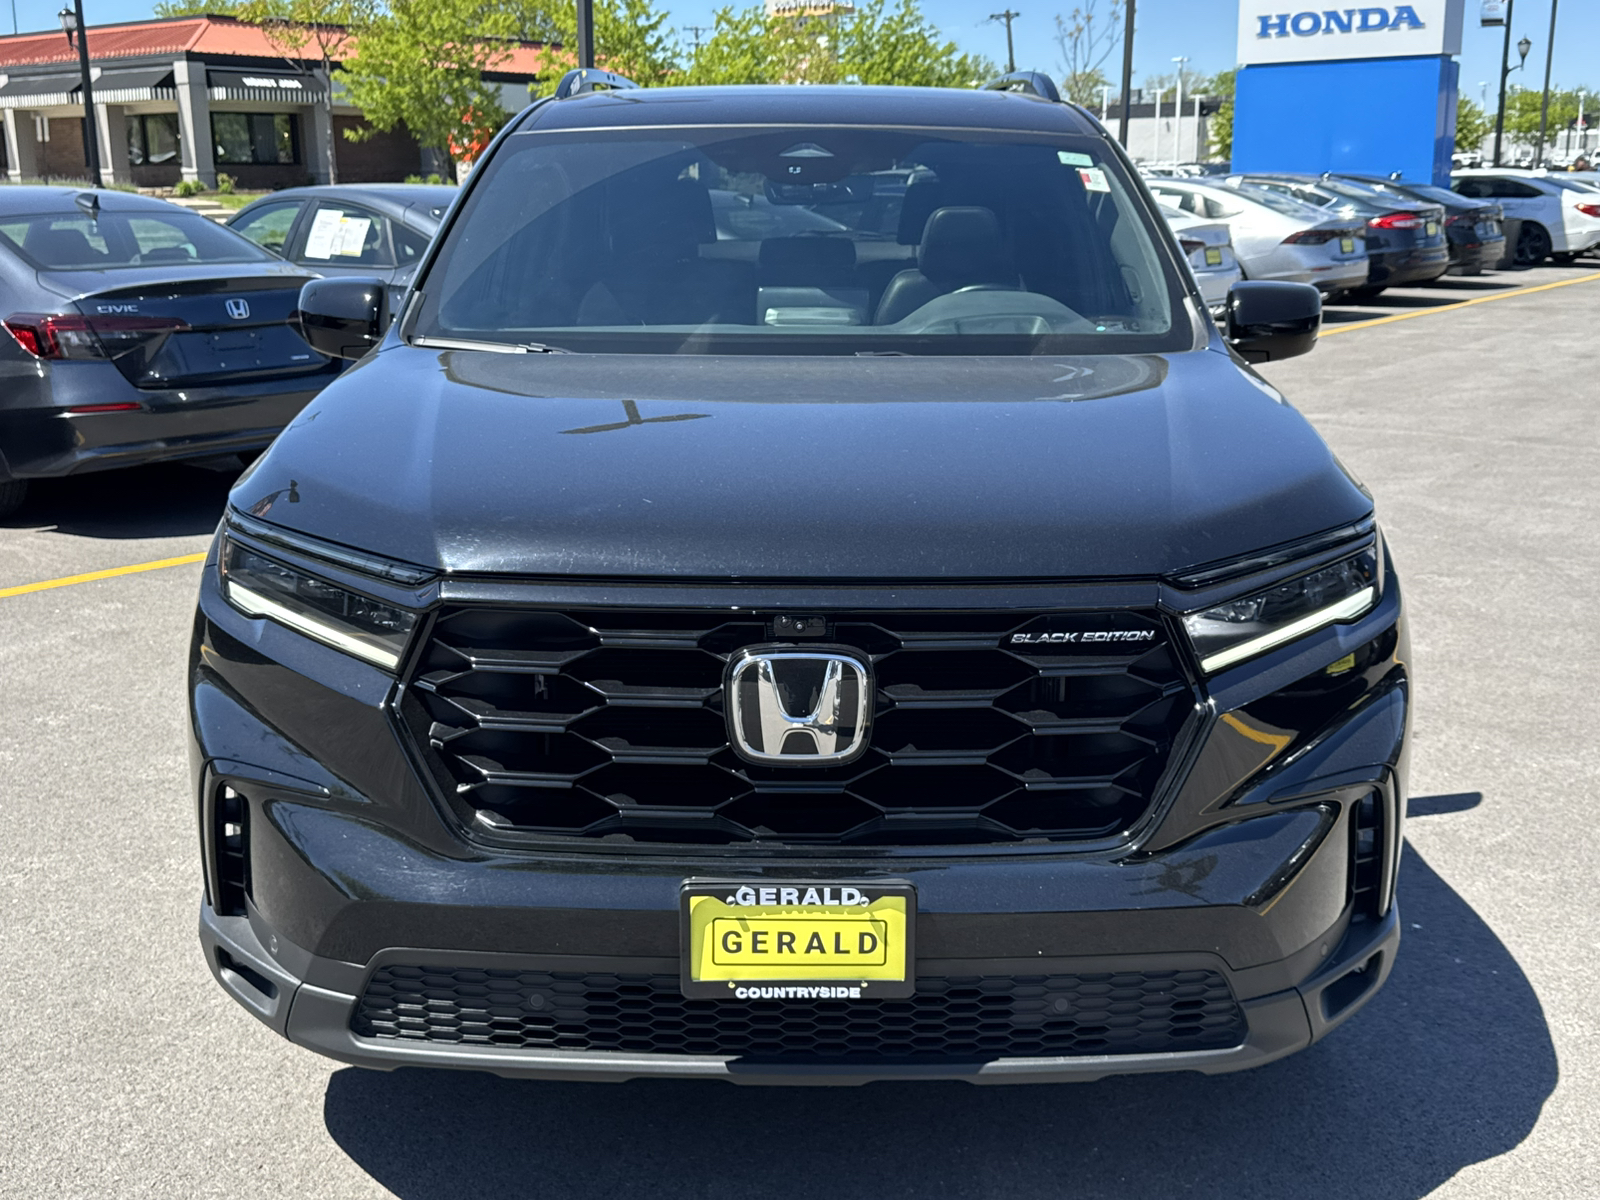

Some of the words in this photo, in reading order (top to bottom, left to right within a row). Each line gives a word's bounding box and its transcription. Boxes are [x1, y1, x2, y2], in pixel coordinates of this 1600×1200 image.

[1256, 5, 1426, 39] HONDA
[97, 304, 139, 314] CIVIC
[1010, 632, 1078, 644] BLACK
[1081, 630, 1155, 642] EDITION
[735, 886, 861, 906] GERALD
[721, 930, 878, 955] GERALD
[735, 986, 861, 999] COUNTRYSIDE
